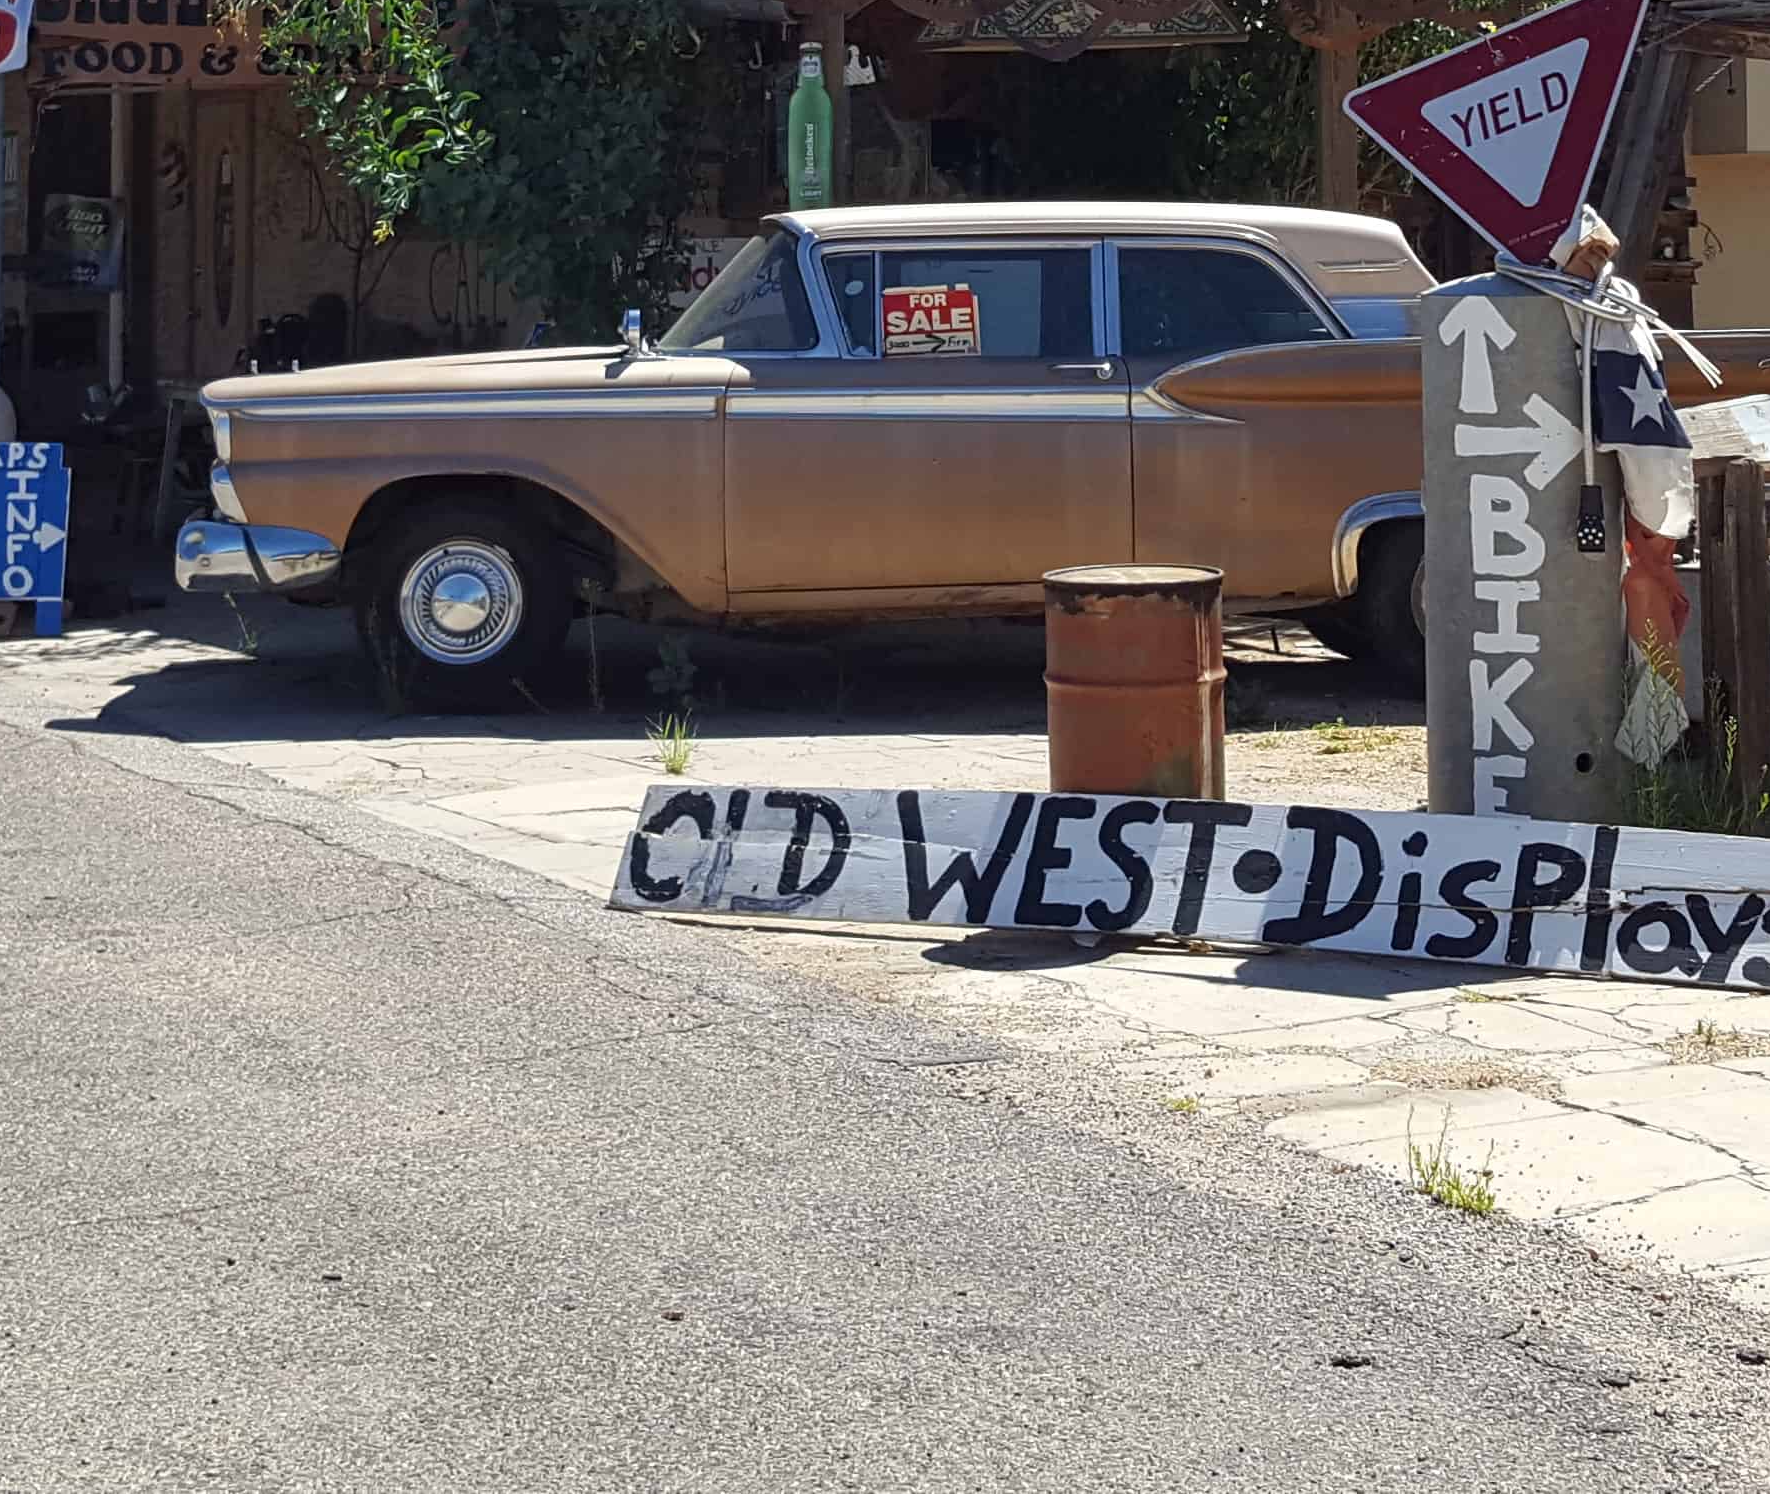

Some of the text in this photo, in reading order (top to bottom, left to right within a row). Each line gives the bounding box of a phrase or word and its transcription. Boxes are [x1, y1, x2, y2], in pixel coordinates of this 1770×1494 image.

[42, 41, 184, 77] FOOD
[198, 42, 239, 76] &
[1449, 72, 1569, 147] YIELD
[887, 307, 973, 333] SALE
[909, 293, 947, 308] FOR
[1, 470, 41, 598] INFO
[896, 789, 1253, 936] WEST
